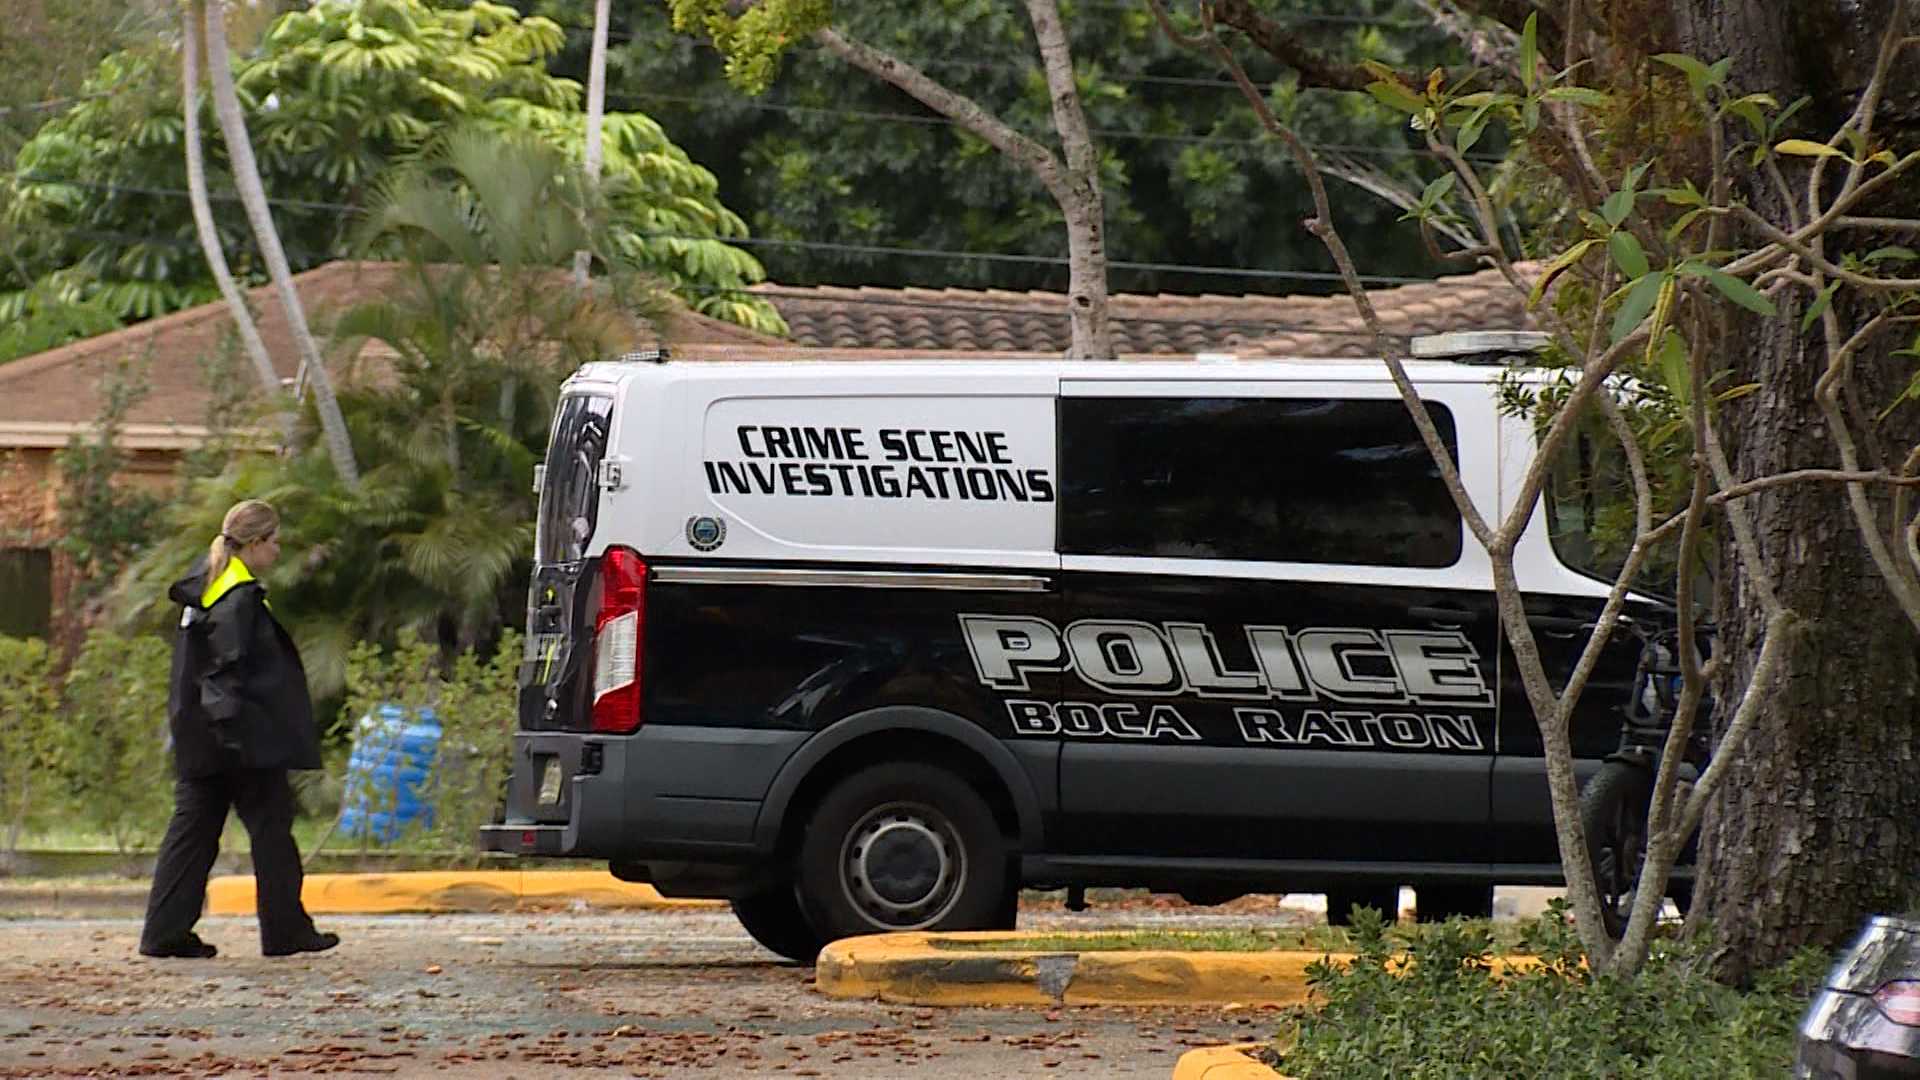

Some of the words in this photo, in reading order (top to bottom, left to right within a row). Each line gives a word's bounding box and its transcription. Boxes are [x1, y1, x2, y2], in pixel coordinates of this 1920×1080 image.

[737, 425, 870, 460] CRIME
[879, 429, 1013, 464] SCENE
[703, 461, 1055, 502] INVESTIGATIONS
[958, 613, 1496, 707] POLICE
[1004, 699, 1202, 739] BOCA
[1233, 707, 1484, 749] RATON
